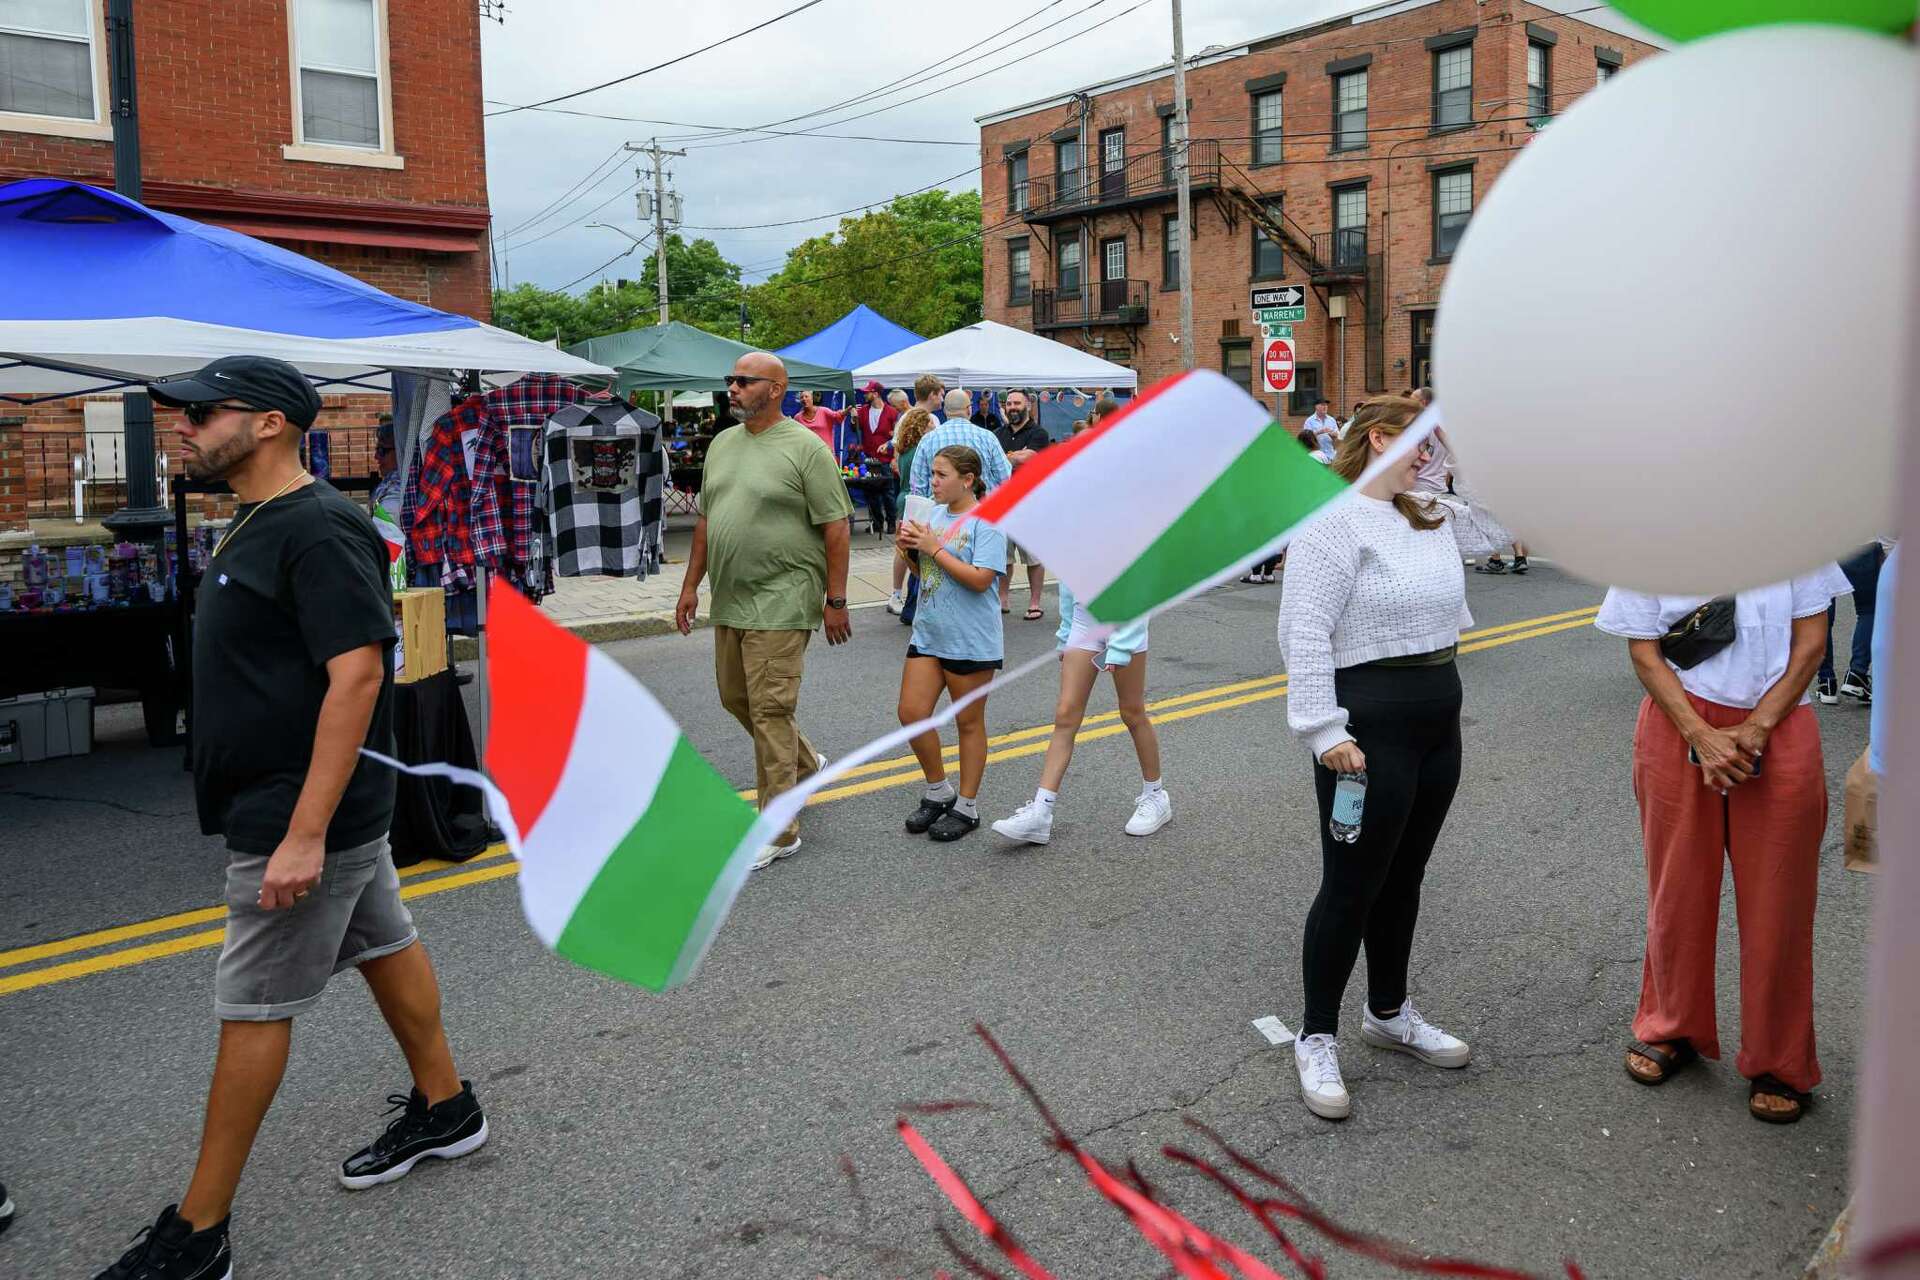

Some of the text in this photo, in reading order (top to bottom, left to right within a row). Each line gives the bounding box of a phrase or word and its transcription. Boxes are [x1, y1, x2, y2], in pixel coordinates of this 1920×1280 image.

[1256, 292, 1288, 303] ONE WAY
[1263, 310, 1295, 320] WARREN
[1268, 350, 1290, 358] DO NOT
[1271, 372, 1288, 380] ENTER
